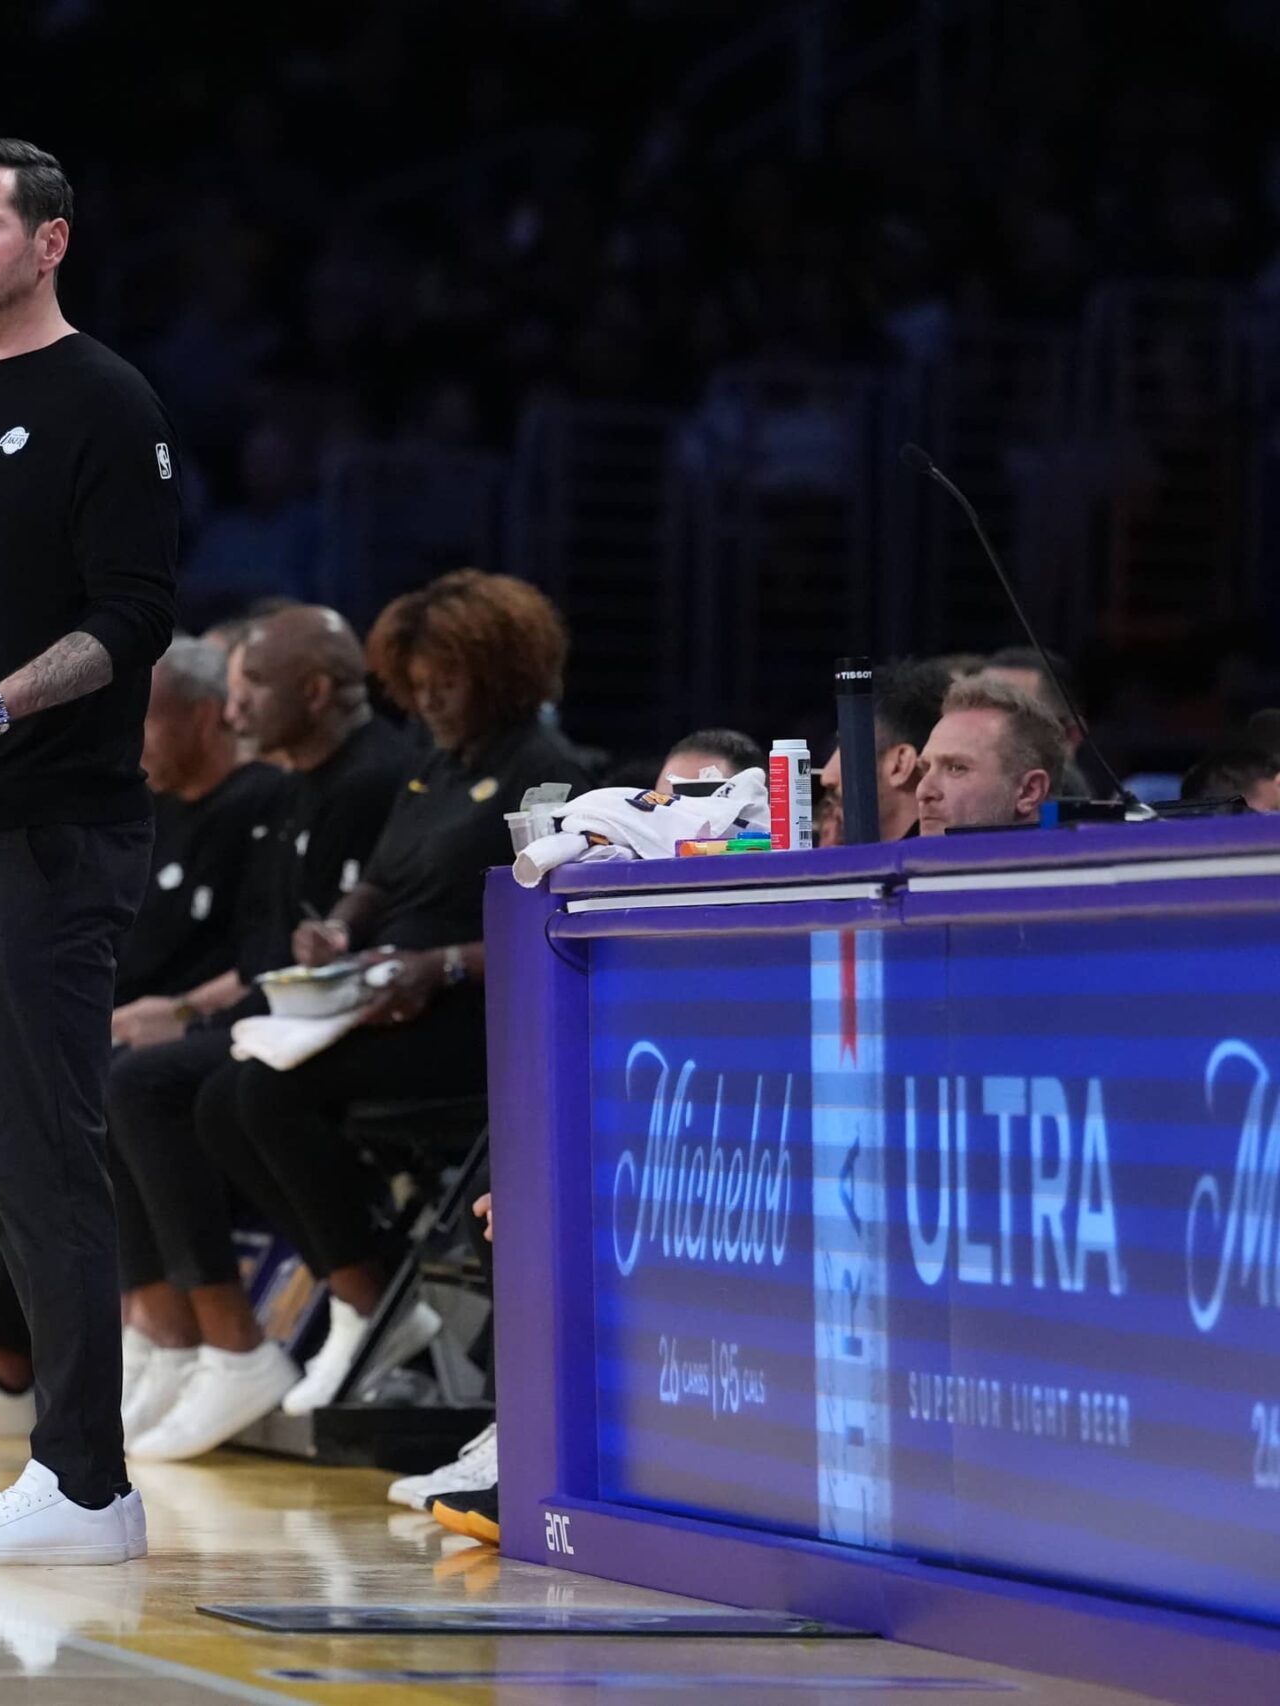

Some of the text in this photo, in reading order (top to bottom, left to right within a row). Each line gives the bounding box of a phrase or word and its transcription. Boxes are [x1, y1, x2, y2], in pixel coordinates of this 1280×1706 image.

[841, 670, 872, 680] TISSOT
[613, 1041, 792, 1277] Michelob
[905, 1076, 1122, 1296] ULTRA
[720, 1342, 739, 1413] 95
[908, 1371, 1130, 1447] SUPERIOR LIGHT BEER
